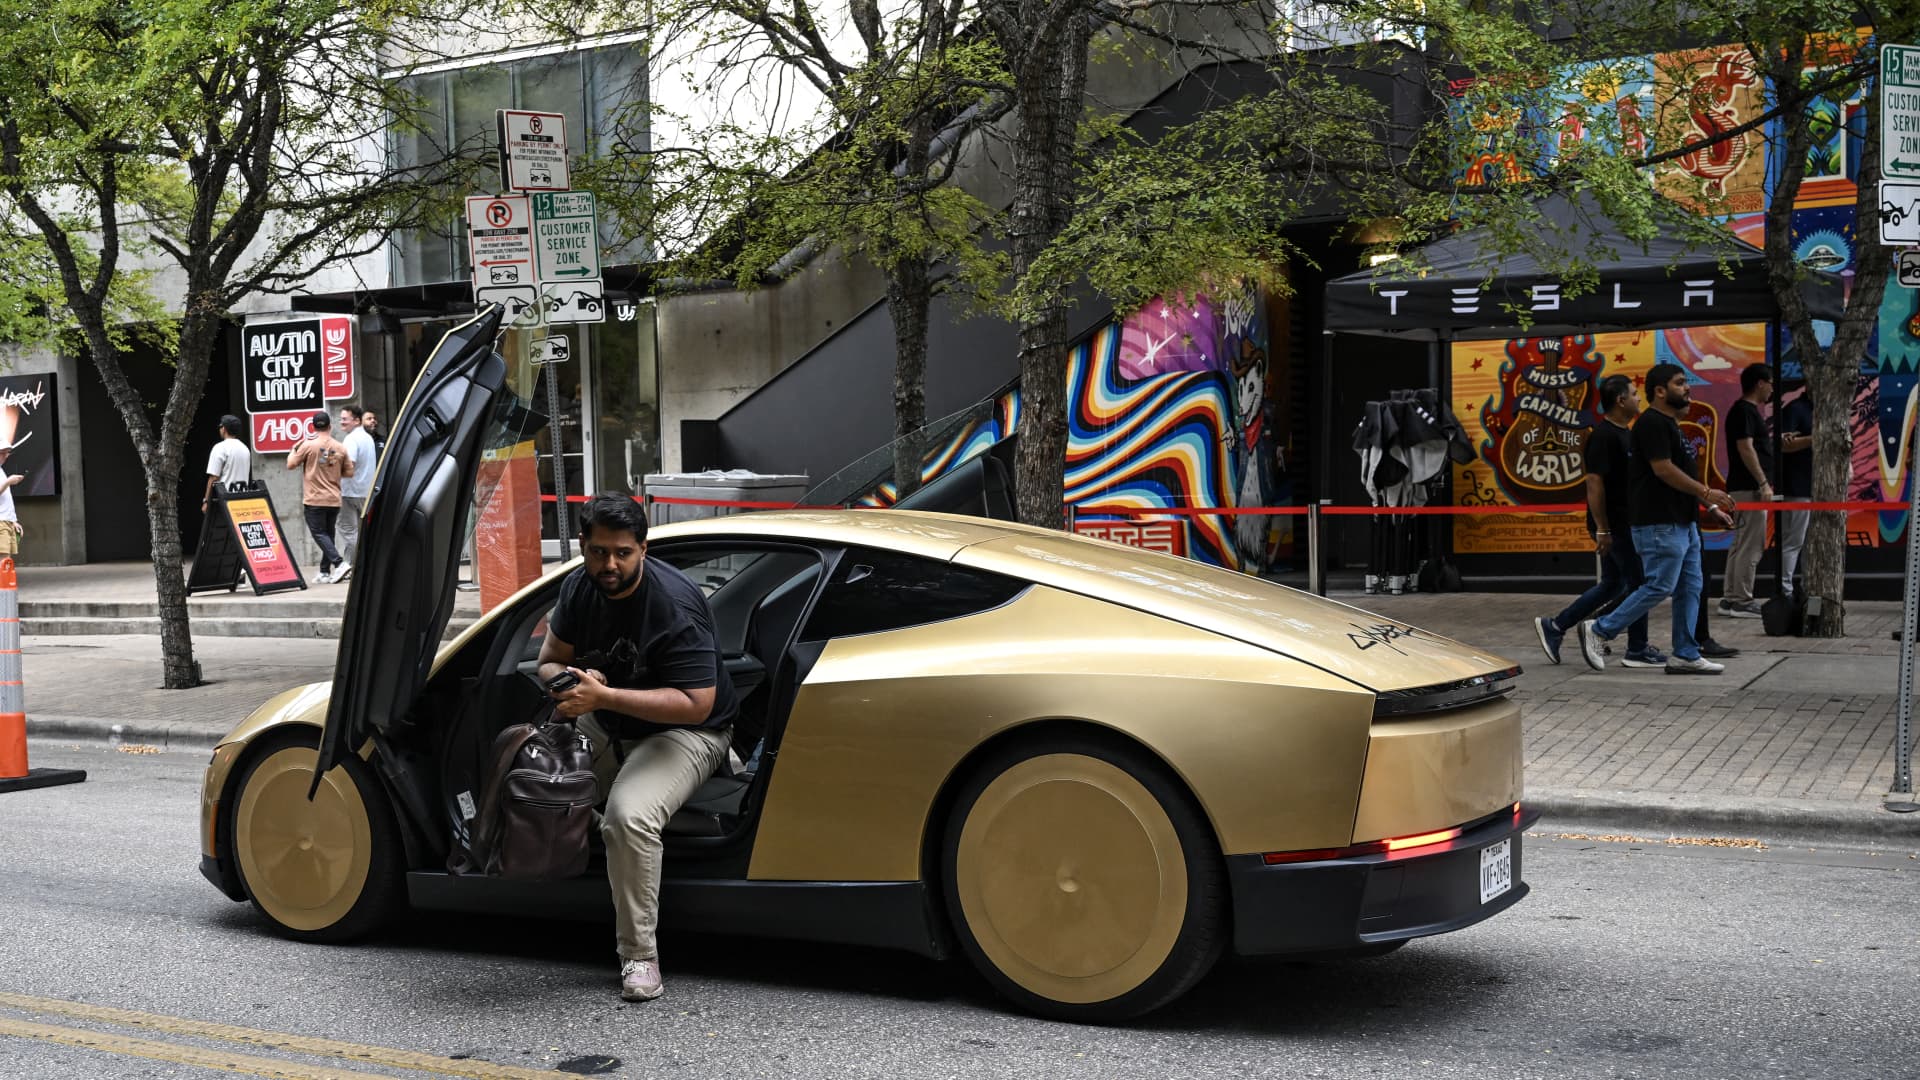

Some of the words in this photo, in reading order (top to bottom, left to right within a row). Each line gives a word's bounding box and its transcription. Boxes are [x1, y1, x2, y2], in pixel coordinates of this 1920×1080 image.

[1886, 48, 1900, 72] 15
[1886, 71, 1900, 85] MIN
[1888, 92, 1920, 111] CUSTO
[1900, 136, 1920, 154] ZON
[536, 194, 550, 210] 15
[537, 210, 551, 220] MIN
[540, 221, 591, 236] CUSTOMER
[547, 236, 587, 250] SERVICE
[556, 251, 581, 265] ZONE
[1379, 280, 1715, 316] TESLA
[250, 330, 316, 356] AUSTIN
[1539, 340, 1560, 351] LIVE
[262, 354, 304, 378] CITY
[1528, 369, 1577, 386] MUSIC
[1520, 395, 1580, 425] CAPITAL
[1523, 428, 1539, 444] OF
[1559, 429, 1580, 446] THE
[1516, 450, 1582, 484] WORLD
